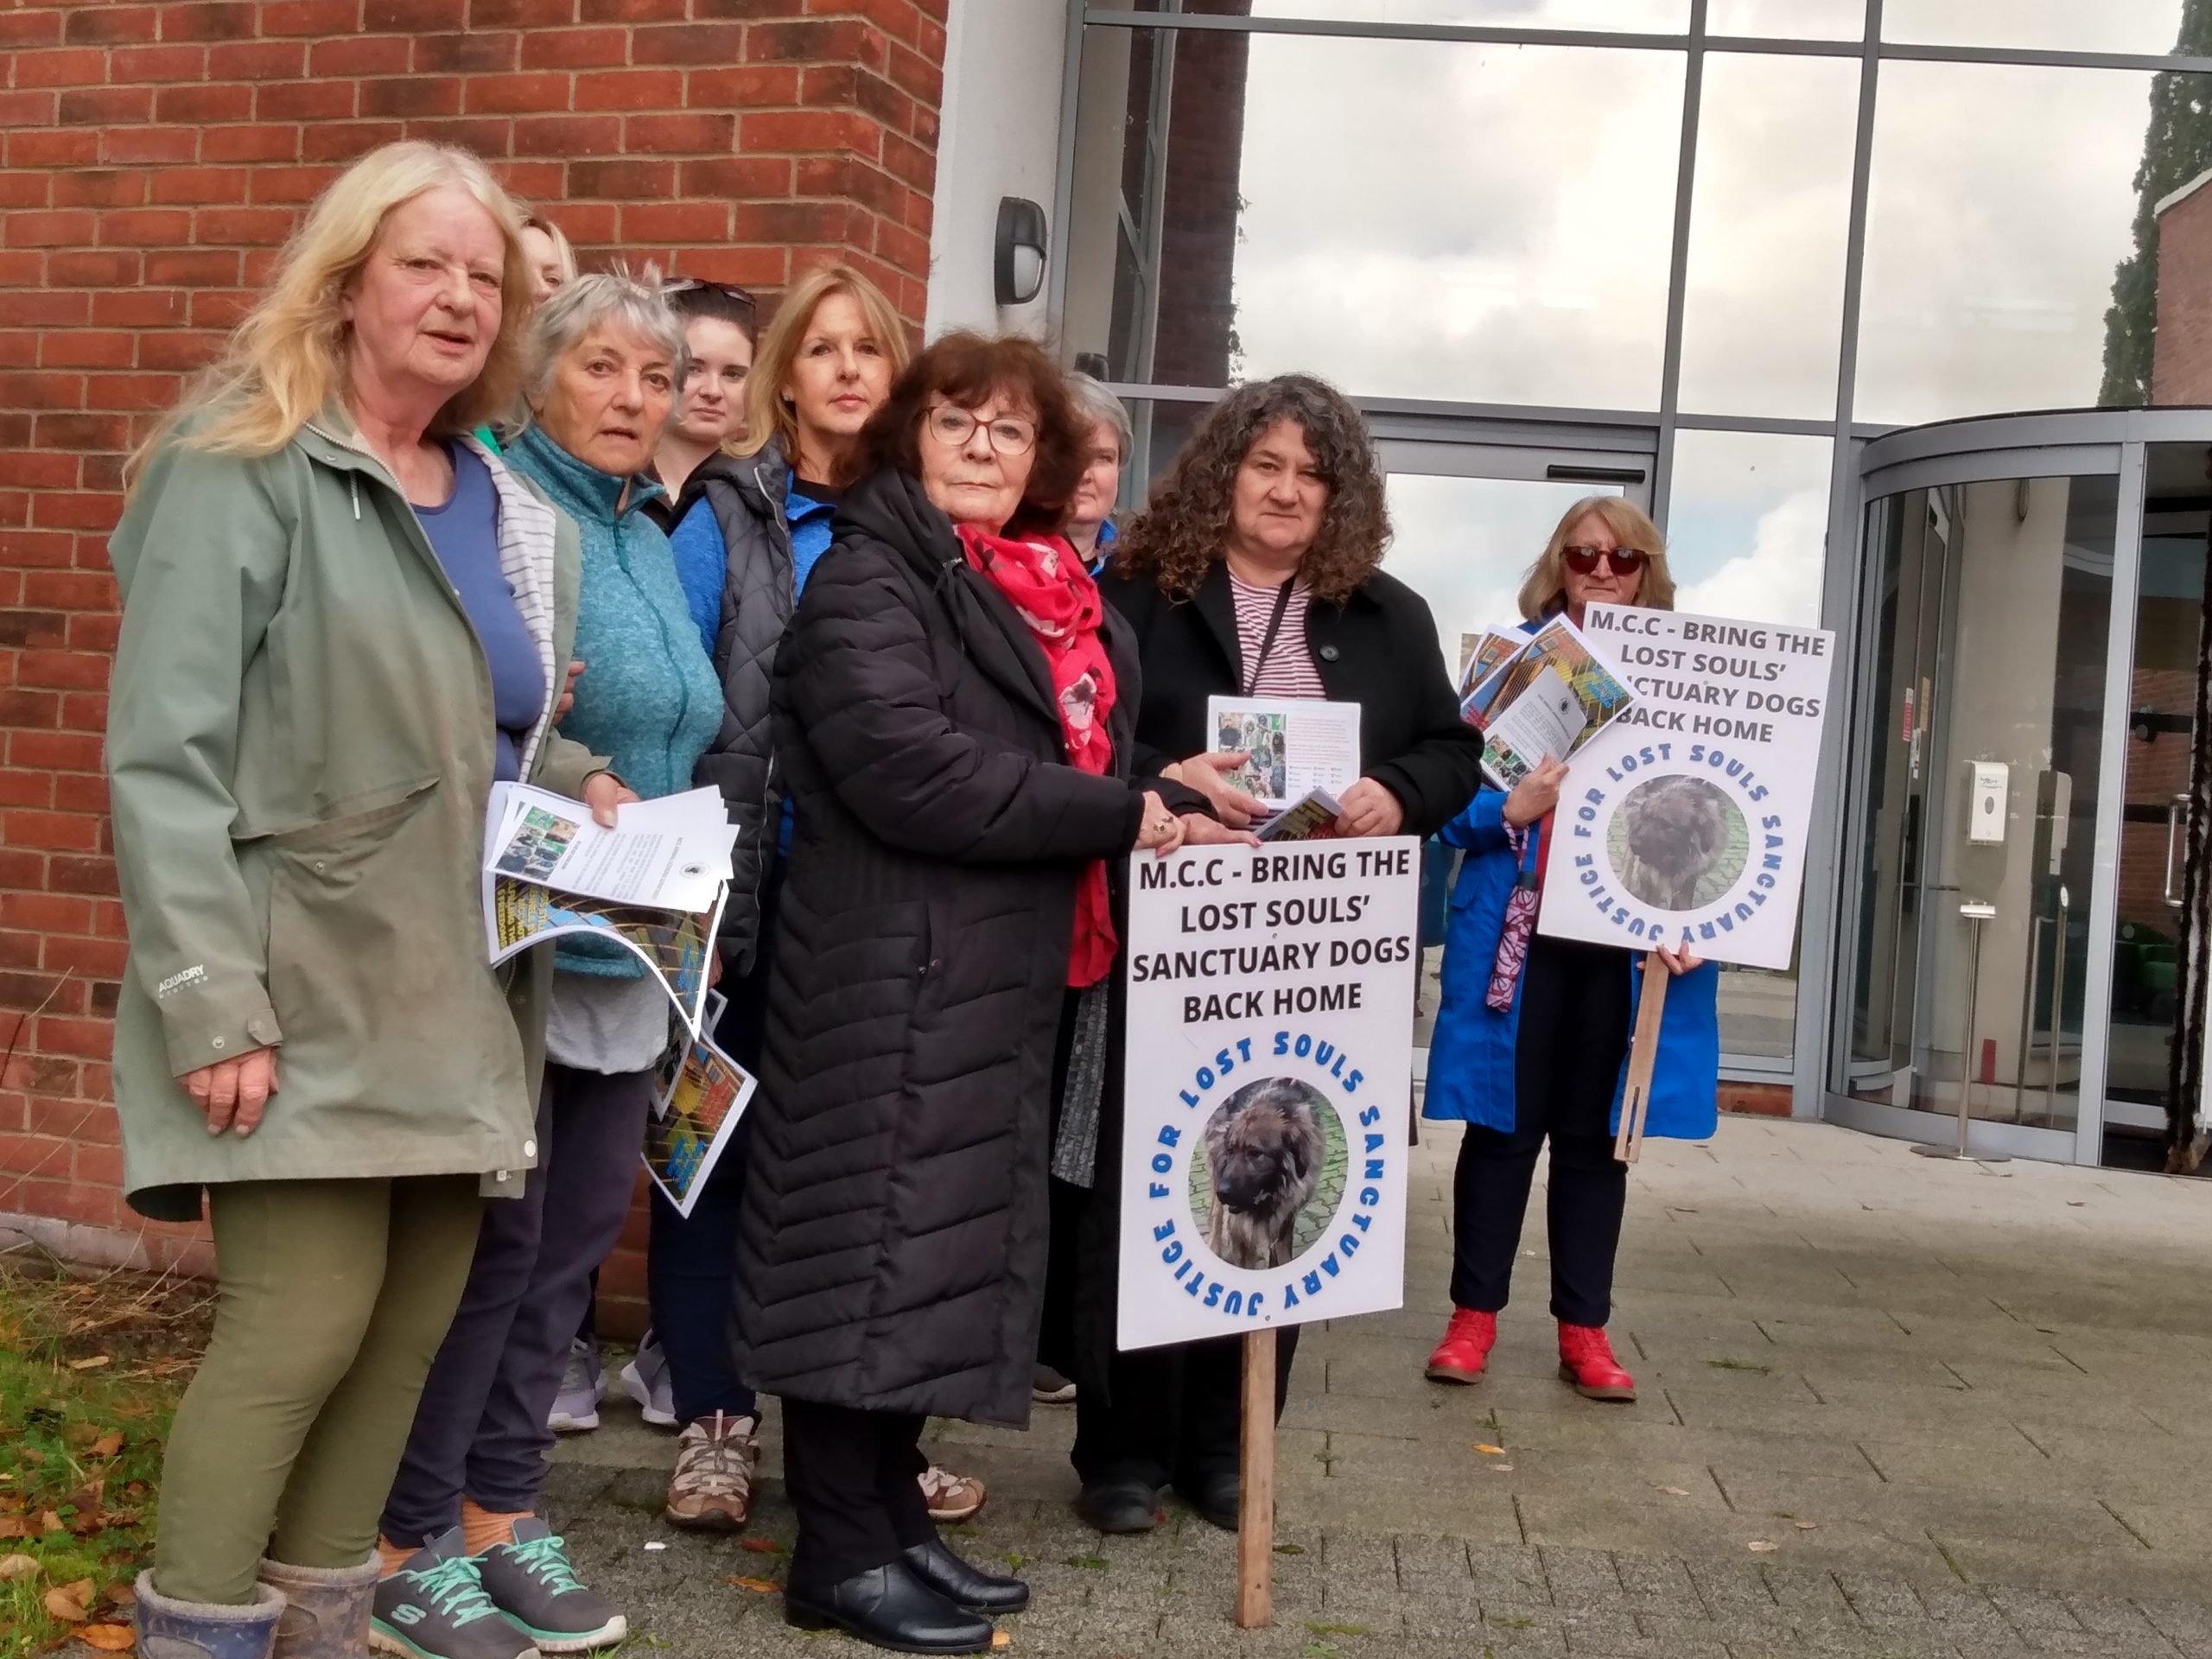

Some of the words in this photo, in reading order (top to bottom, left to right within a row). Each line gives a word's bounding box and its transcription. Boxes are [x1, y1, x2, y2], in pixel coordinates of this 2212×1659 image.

[1591, 610, 1661, 636] M.C.C
[1683, 621, 1767, 649] BRING
[1776, 632, 1826, 656] THE
[1621, 644, 1686, 670] LOST
[1616, 707, 1687, 732] BACK
[1693, 715, 1773, 742] HOME
[1745, 691, 1821, 717] DOGS
[1606, 743, 1671, 782] LOST
[1689, 745, 1769, 801] SOULS
[1574, 787, 1605, 837] FOR
[1140, 859, 1224, 889] M.C.C
[1251, 852, 1346, 883] BRING
[1357, 849, 1410, 877] THE
[1681, 815, 1783, 944] SANCTUARY
[1181, 902, 1256, 933] LOST
[1575, 854, 1663, 942] JUSTICE
[159, 964, 204, 993] AQUADRY
[1133, 942, 1320, 982] SANCTUARY
[1330, 936, 1410, 967] DOGS
[1184, 991, 1264, 1023] BACK
[1274, 982, 1362, 1015] HOME
[1179, 1037, 1251, 1108] LOST
[1273, 1031, 1363, 1092] SOULS
[1149, 1124, 1181, 1198] FOR
[1284, 1105, 1385, 1309] SANCTUARY
[1154, 1218, 1264, 1316] JUSTICE
